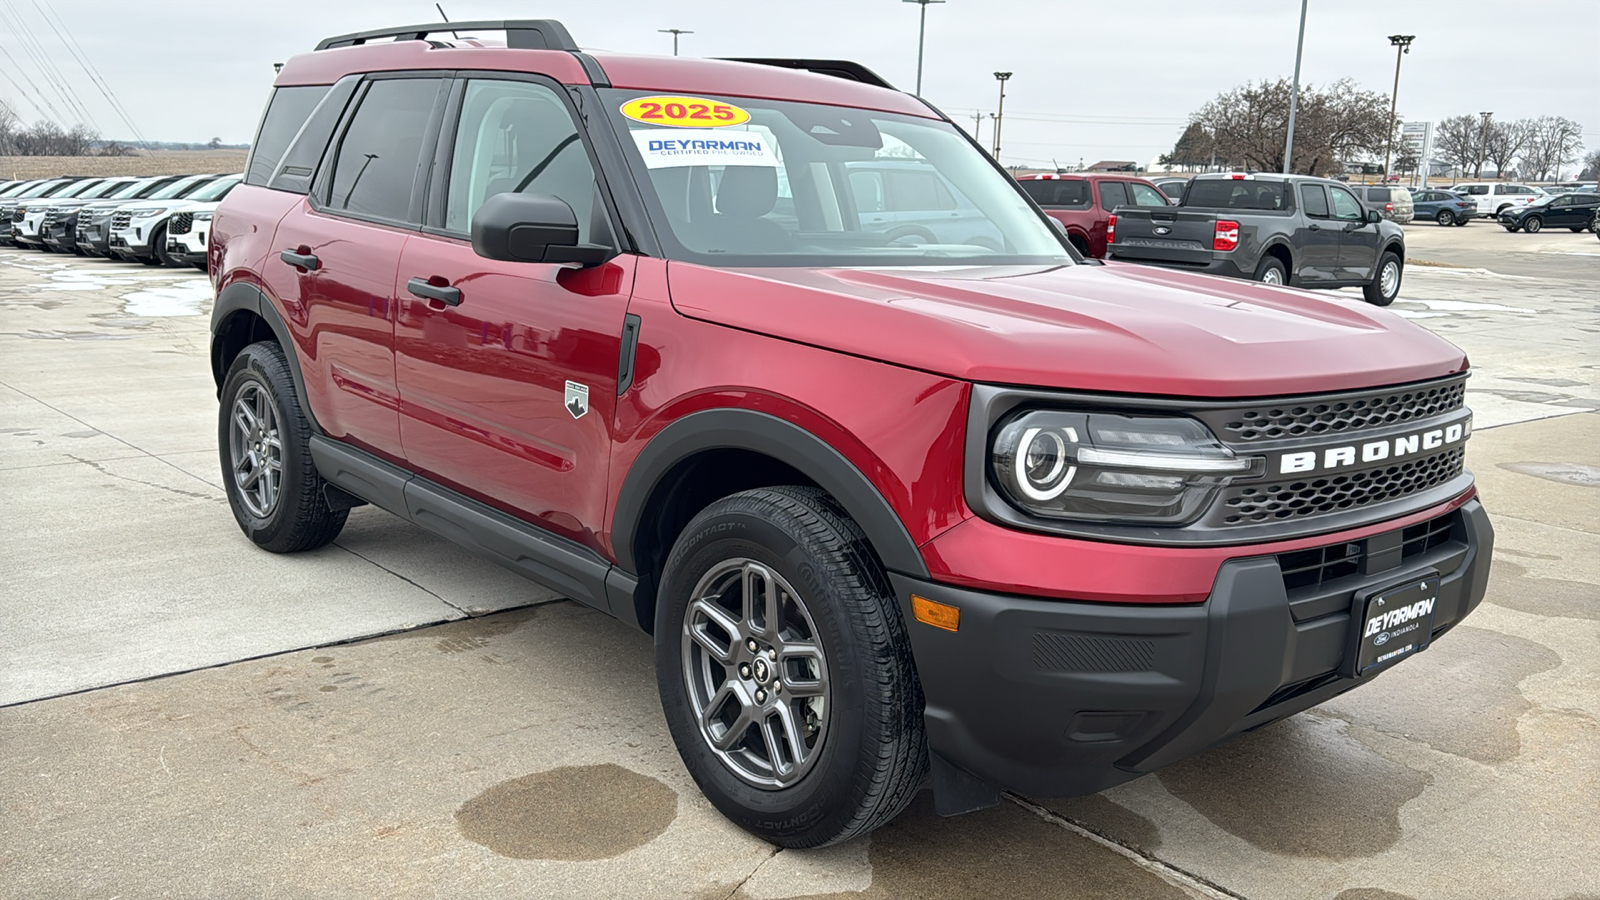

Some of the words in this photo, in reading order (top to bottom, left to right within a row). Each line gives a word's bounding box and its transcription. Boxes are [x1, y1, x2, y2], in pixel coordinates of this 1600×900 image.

[639, 102, 735, 121] 2025
[648, 139, 762, 152] DEYARMAN
[1279, 423, 1463, 475] BRONCO
[1364, 597, 1436, 638] DEYARMAN
[1390, 622, 1419, 639] INDIANOLA
